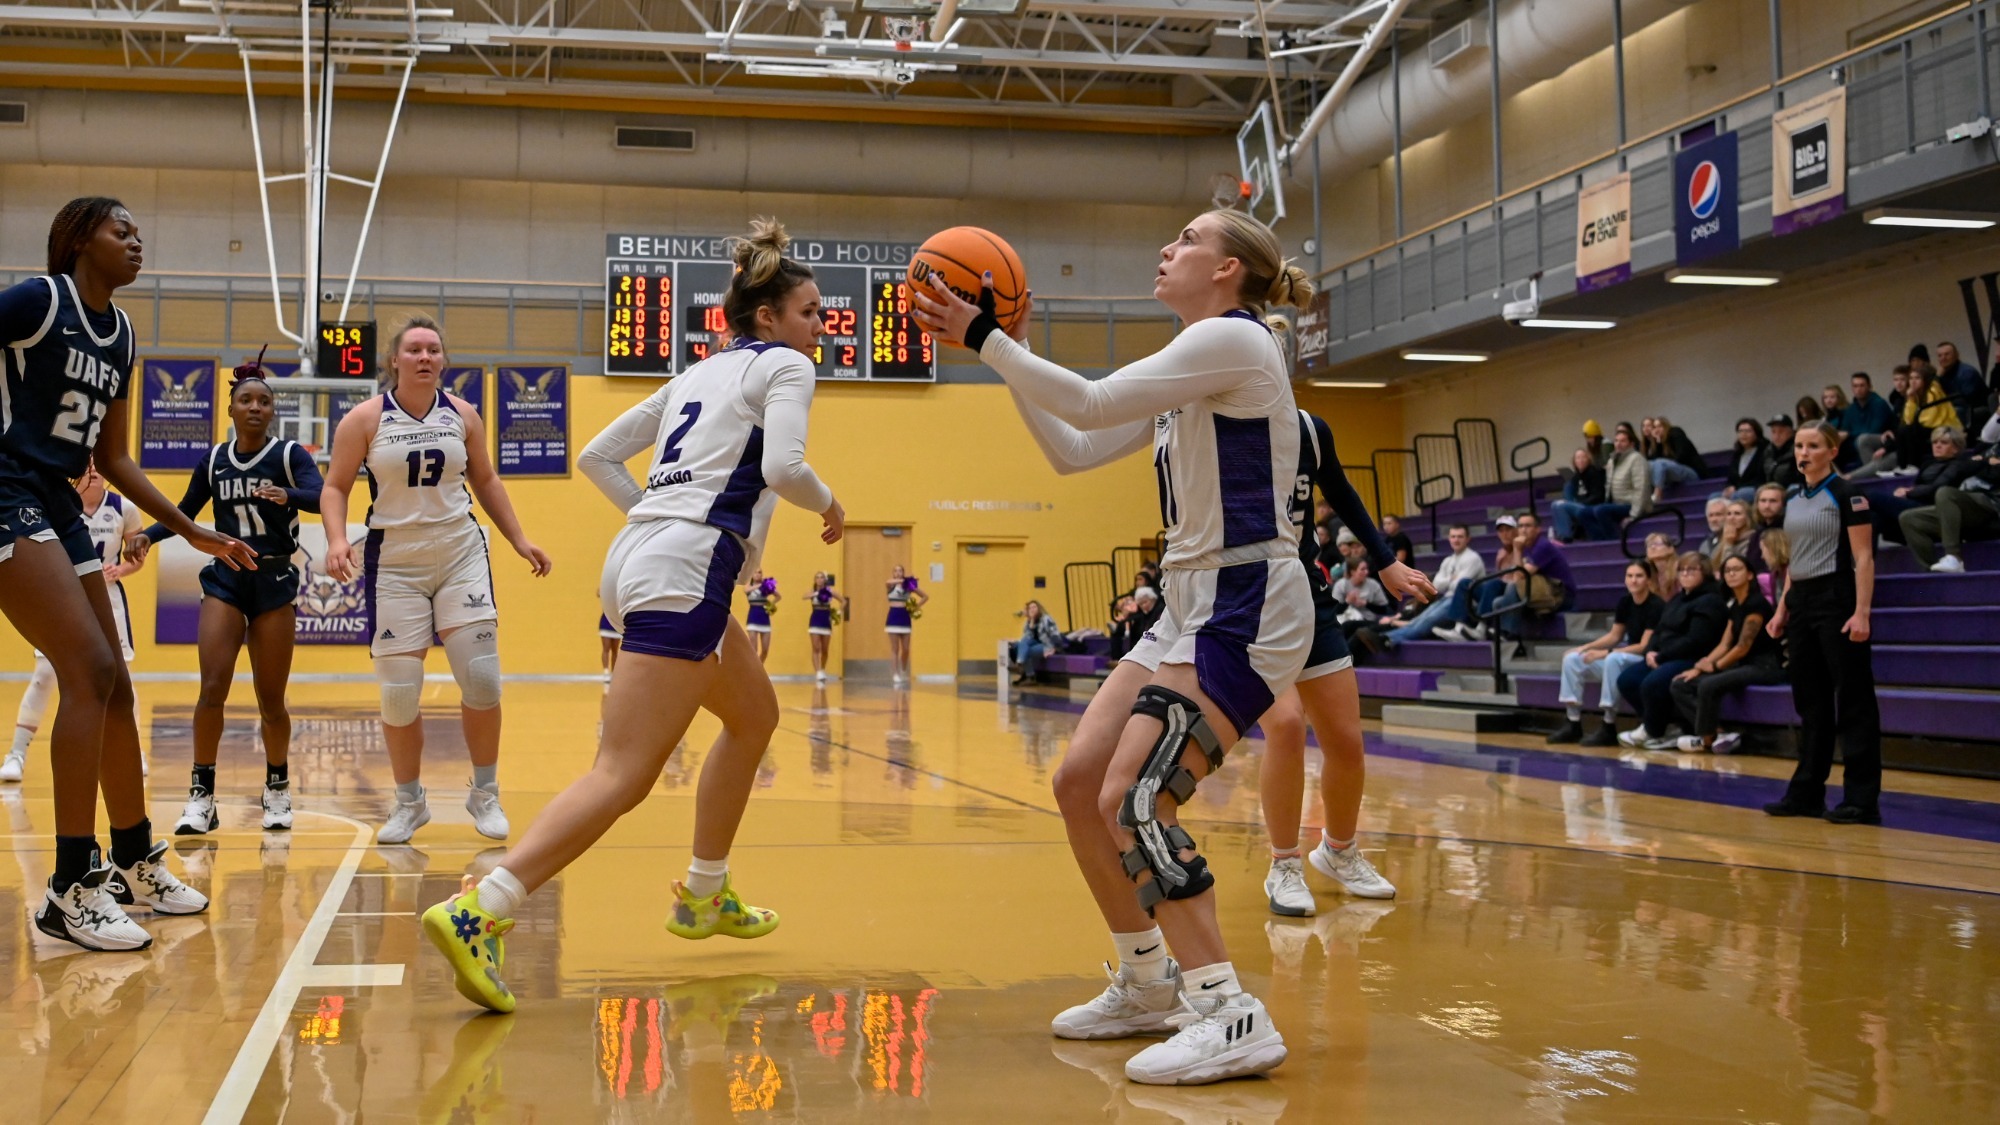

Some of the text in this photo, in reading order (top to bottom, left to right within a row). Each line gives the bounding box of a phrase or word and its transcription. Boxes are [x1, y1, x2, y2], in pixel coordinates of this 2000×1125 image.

[1795, 139, 1826, 170] BIG-D
[1597, 210, 1628, 230] GAME
[1597, 226, 1619, 243] ONE
[1691, 216, 1720, 243] pepsi
[620, 276, 670, 292] 2 0 0
[883, 283, 893, 298] 2
[615, 292, 670, 307] 11 0 0
[878, 300, 893, 313] 11
[615, 308, 670, 324] 13 0 0
[824, 310, 856, 335] 22
[323, 328, 361, 346] 43.9
[610, 324, 670, 340] 24 0 0
[873, 331, 893, 346] 22
[897, 331, 907, 346] 0
[610, 341, 670, 357] 25 2 0
[842, 346, 854, 365] 2
[873, 347, 893, 362] 25
[897, 347, 907, 362] 0
[341, 346, 364, 375] 15
[64, 347, 121, 399] UAFS
[660, 401, 702, 464] 2
[405, 448, 446, 488] 13
[233, 503, 266, 538] 11
[294, 616, 368, 632] STMINS
